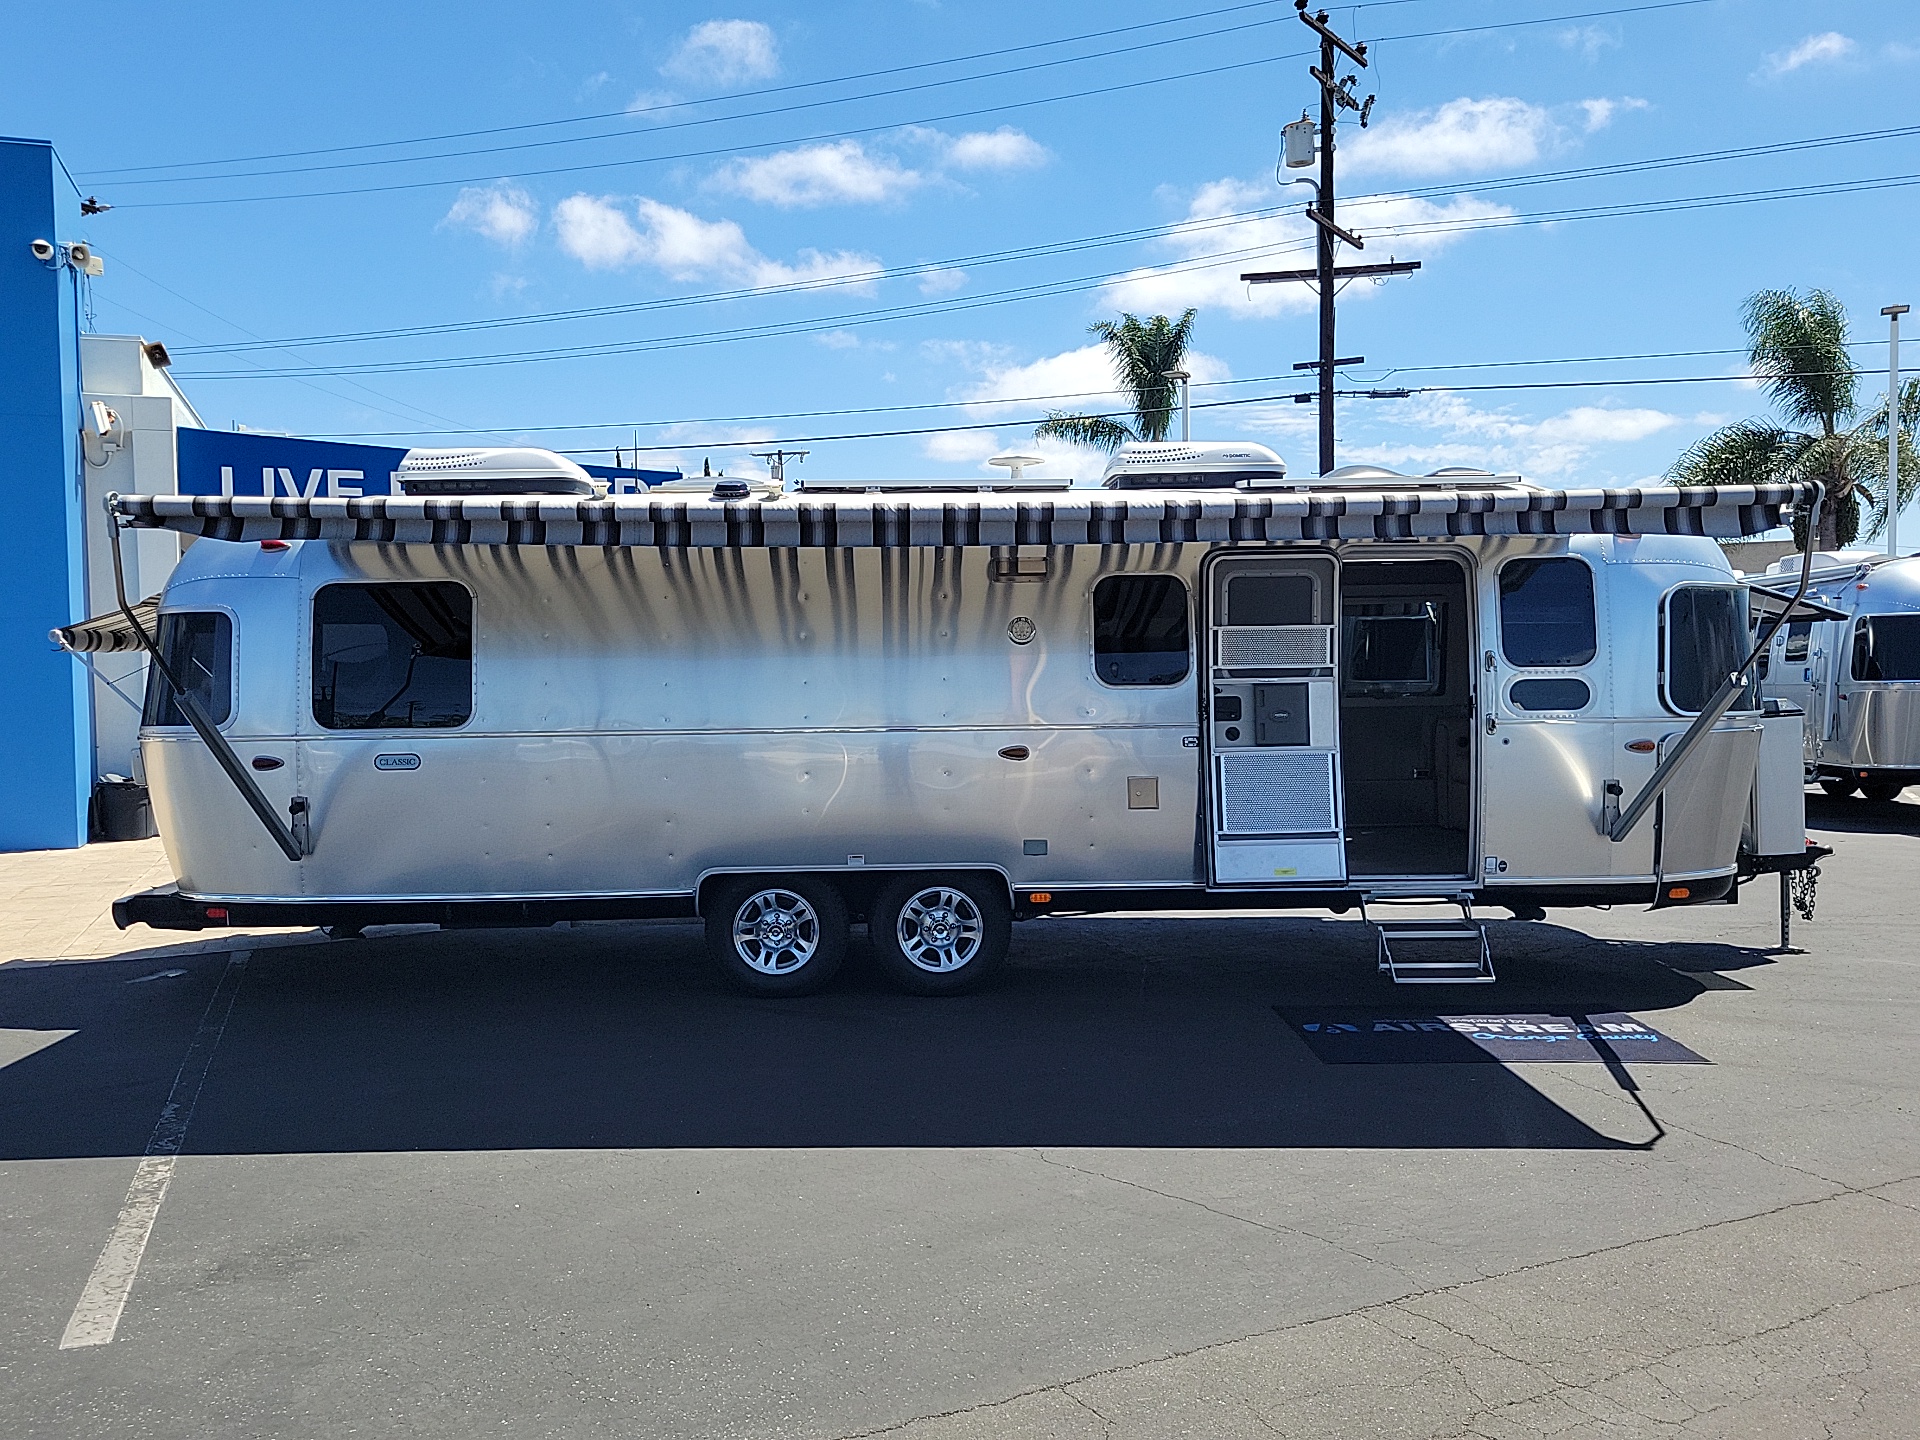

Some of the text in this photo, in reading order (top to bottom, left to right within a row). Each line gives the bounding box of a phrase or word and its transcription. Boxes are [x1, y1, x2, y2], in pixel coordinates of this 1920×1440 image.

[379, 758, 416, 766] CLASSIC
[1373, 1022, 1648, 1033] AIRSTREAM
[1472, 1032, 1570, 1043] Orange
